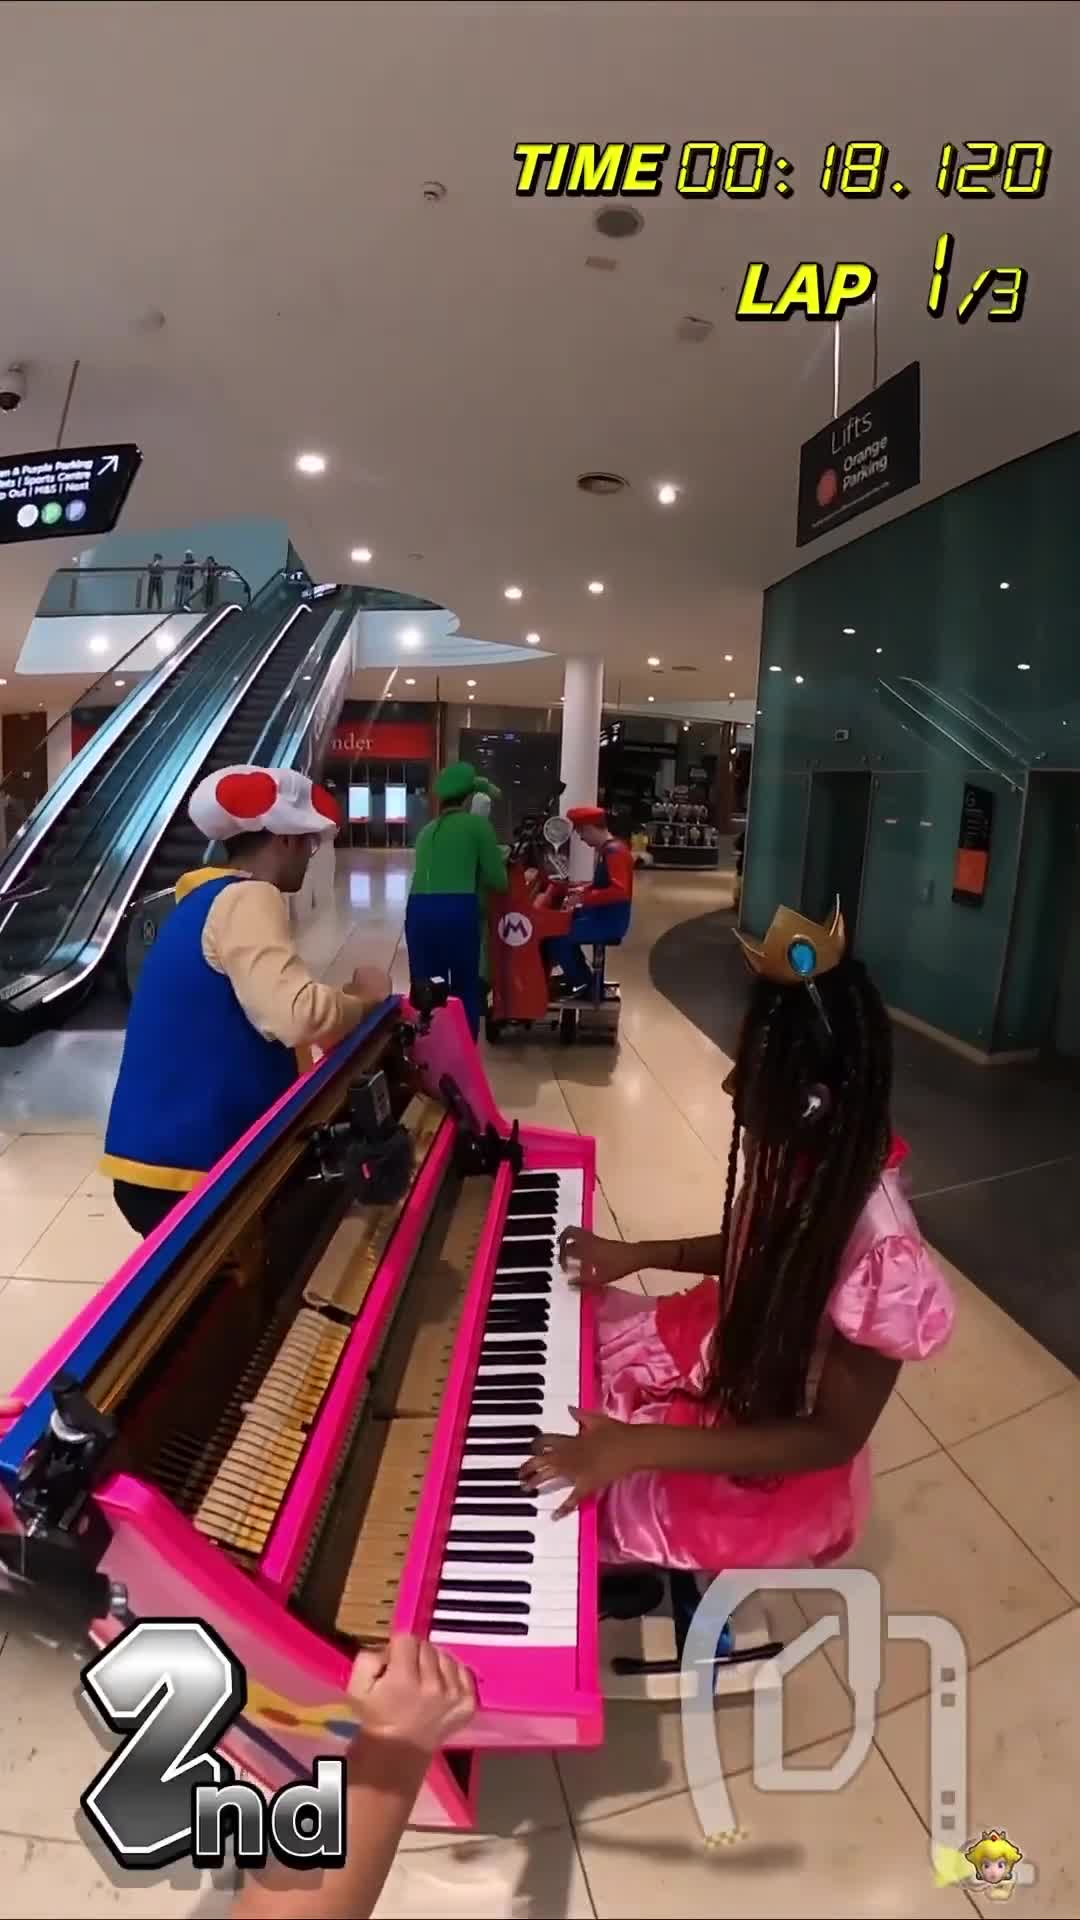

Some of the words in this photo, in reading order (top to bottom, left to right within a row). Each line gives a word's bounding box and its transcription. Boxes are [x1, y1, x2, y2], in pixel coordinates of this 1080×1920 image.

[831, 412, 872, 454] Lifts
[843, 436, 888, 471] Orange
[22, 463, 53, 475] Purple
[55, 460, 94, 470] Parking
[843, 455, 888, 491] Parking
[23, 474, 55, 486] Sports
[57, 471, 91, 482] Centre
[65, 481, 89, 492] Next
[331, 731, 374, 750] nder
